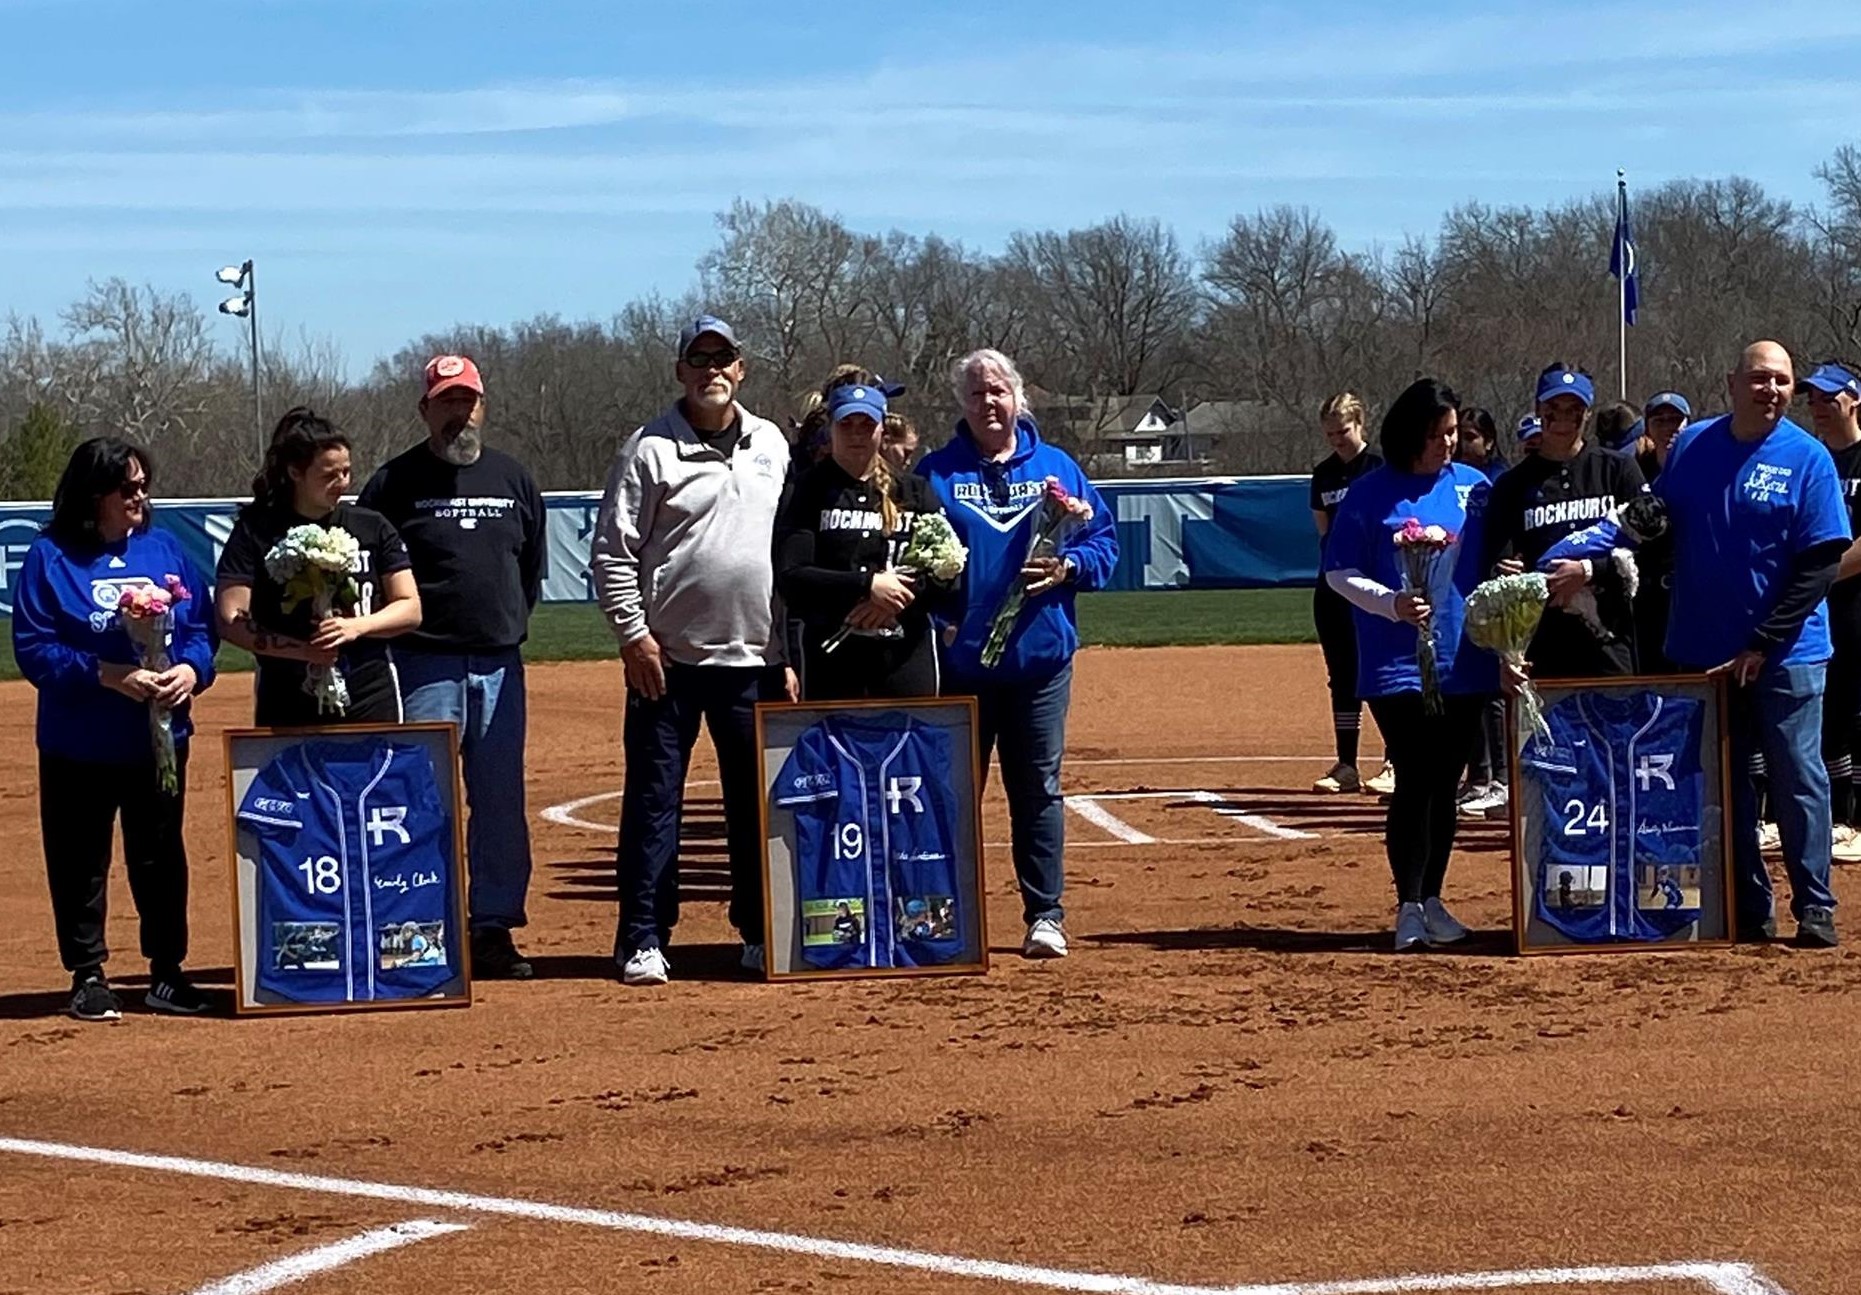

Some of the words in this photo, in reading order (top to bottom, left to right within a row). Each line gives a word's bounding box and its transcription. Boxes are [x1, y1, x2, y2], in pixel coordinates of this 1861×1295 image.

[434, 508, 503, 518] SOFTBALL
[1563, 799, 1610, 836] 24
[830, 822, 864, 861] 19
[298, 855, 341, 895] 18
